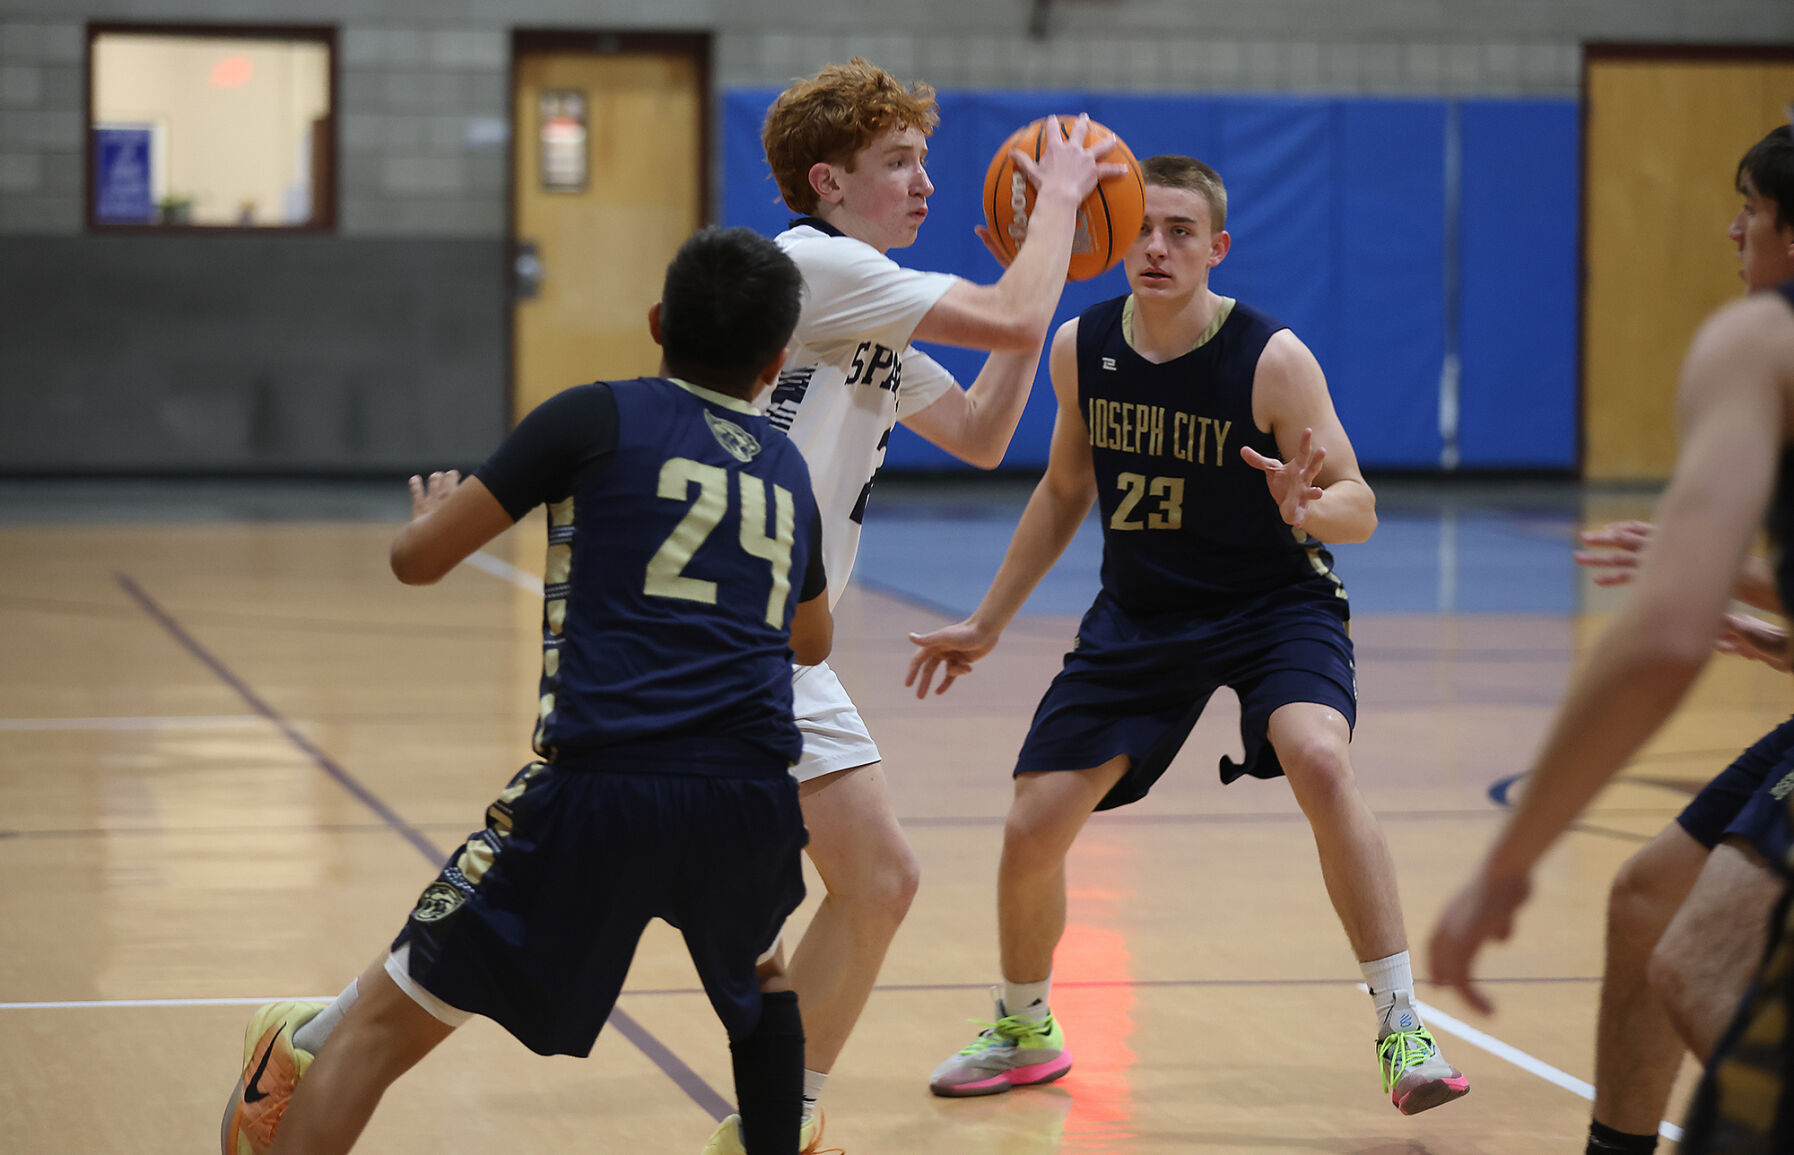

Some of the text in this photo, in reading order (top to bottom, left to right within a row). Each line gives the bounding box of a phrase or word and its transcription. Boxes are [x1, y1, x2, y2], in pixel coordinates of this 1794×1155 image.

[844, 341, 902, 393] SPA
[1174, 411, 1232, 467] CITY
[1110, 471, 1185, 531] 23
[643, 457, 795, 631] 24
